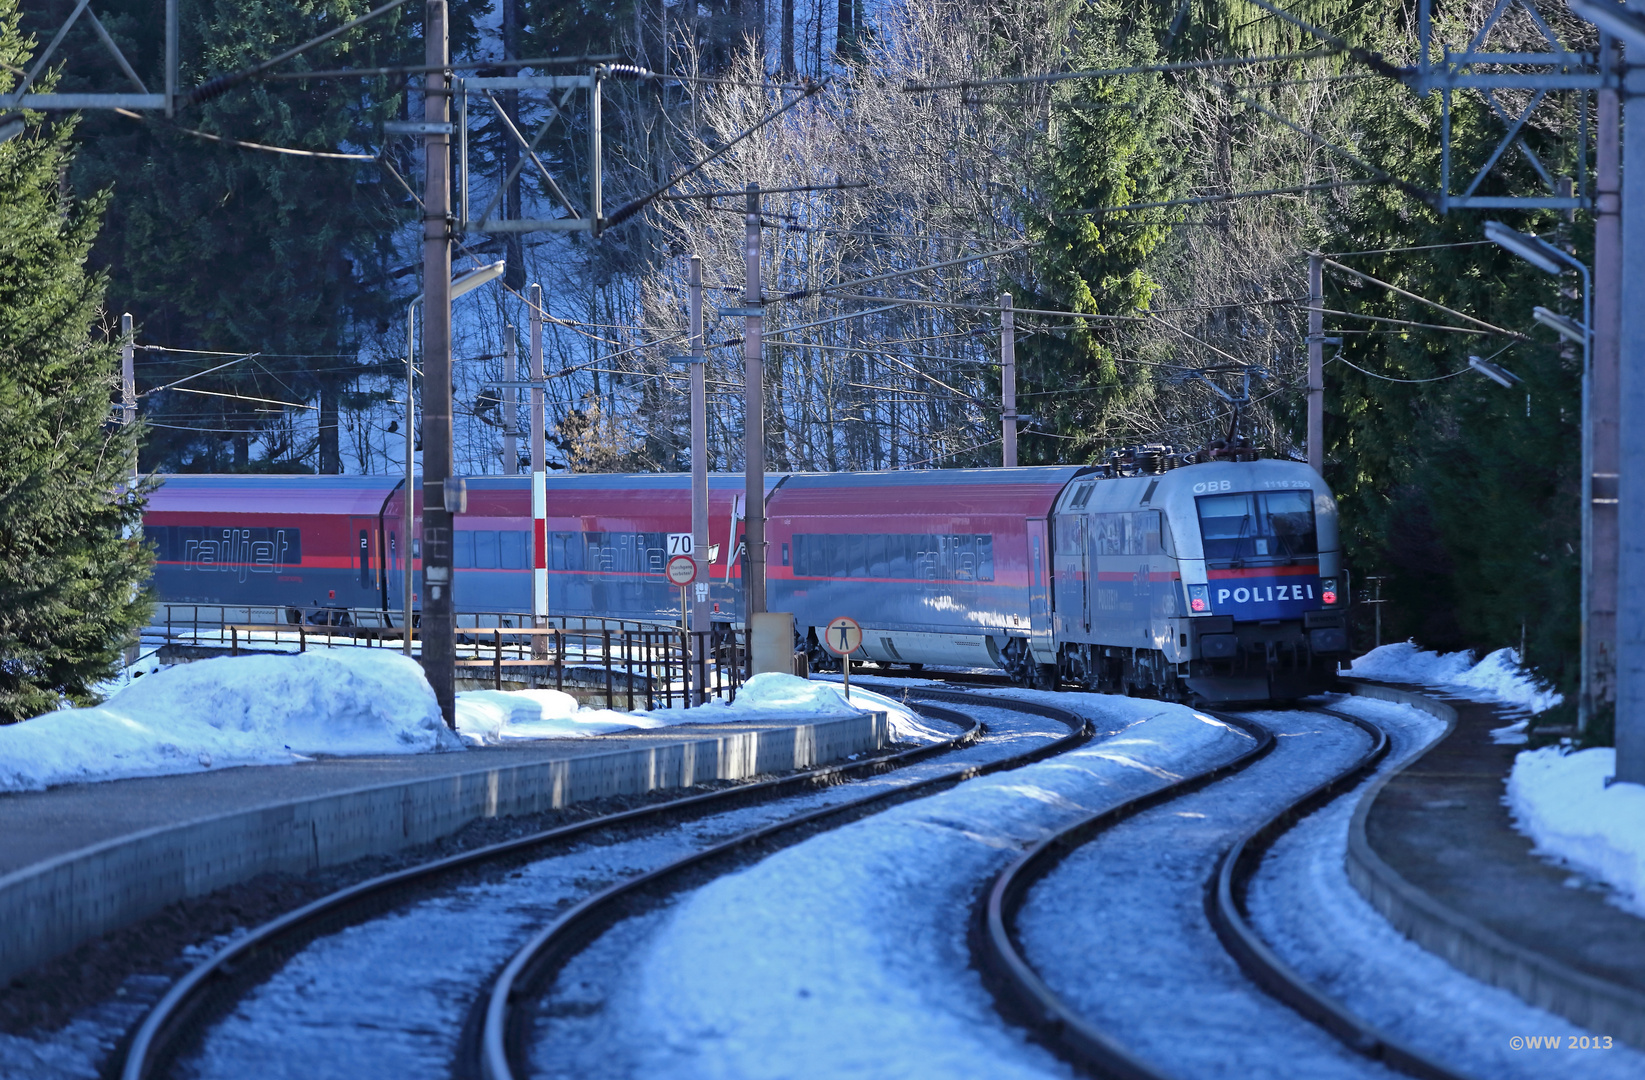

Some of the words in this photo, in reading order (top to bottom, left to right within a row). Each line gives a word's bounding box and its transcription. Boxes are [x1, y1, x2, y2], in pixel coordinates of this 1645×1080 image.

[360, 538, 367, 549] 2
[670, 535, 692, 554] 70
[184, 529, 288, 584] railjet
[1217, 584, 1314, 604] POLIZEI
